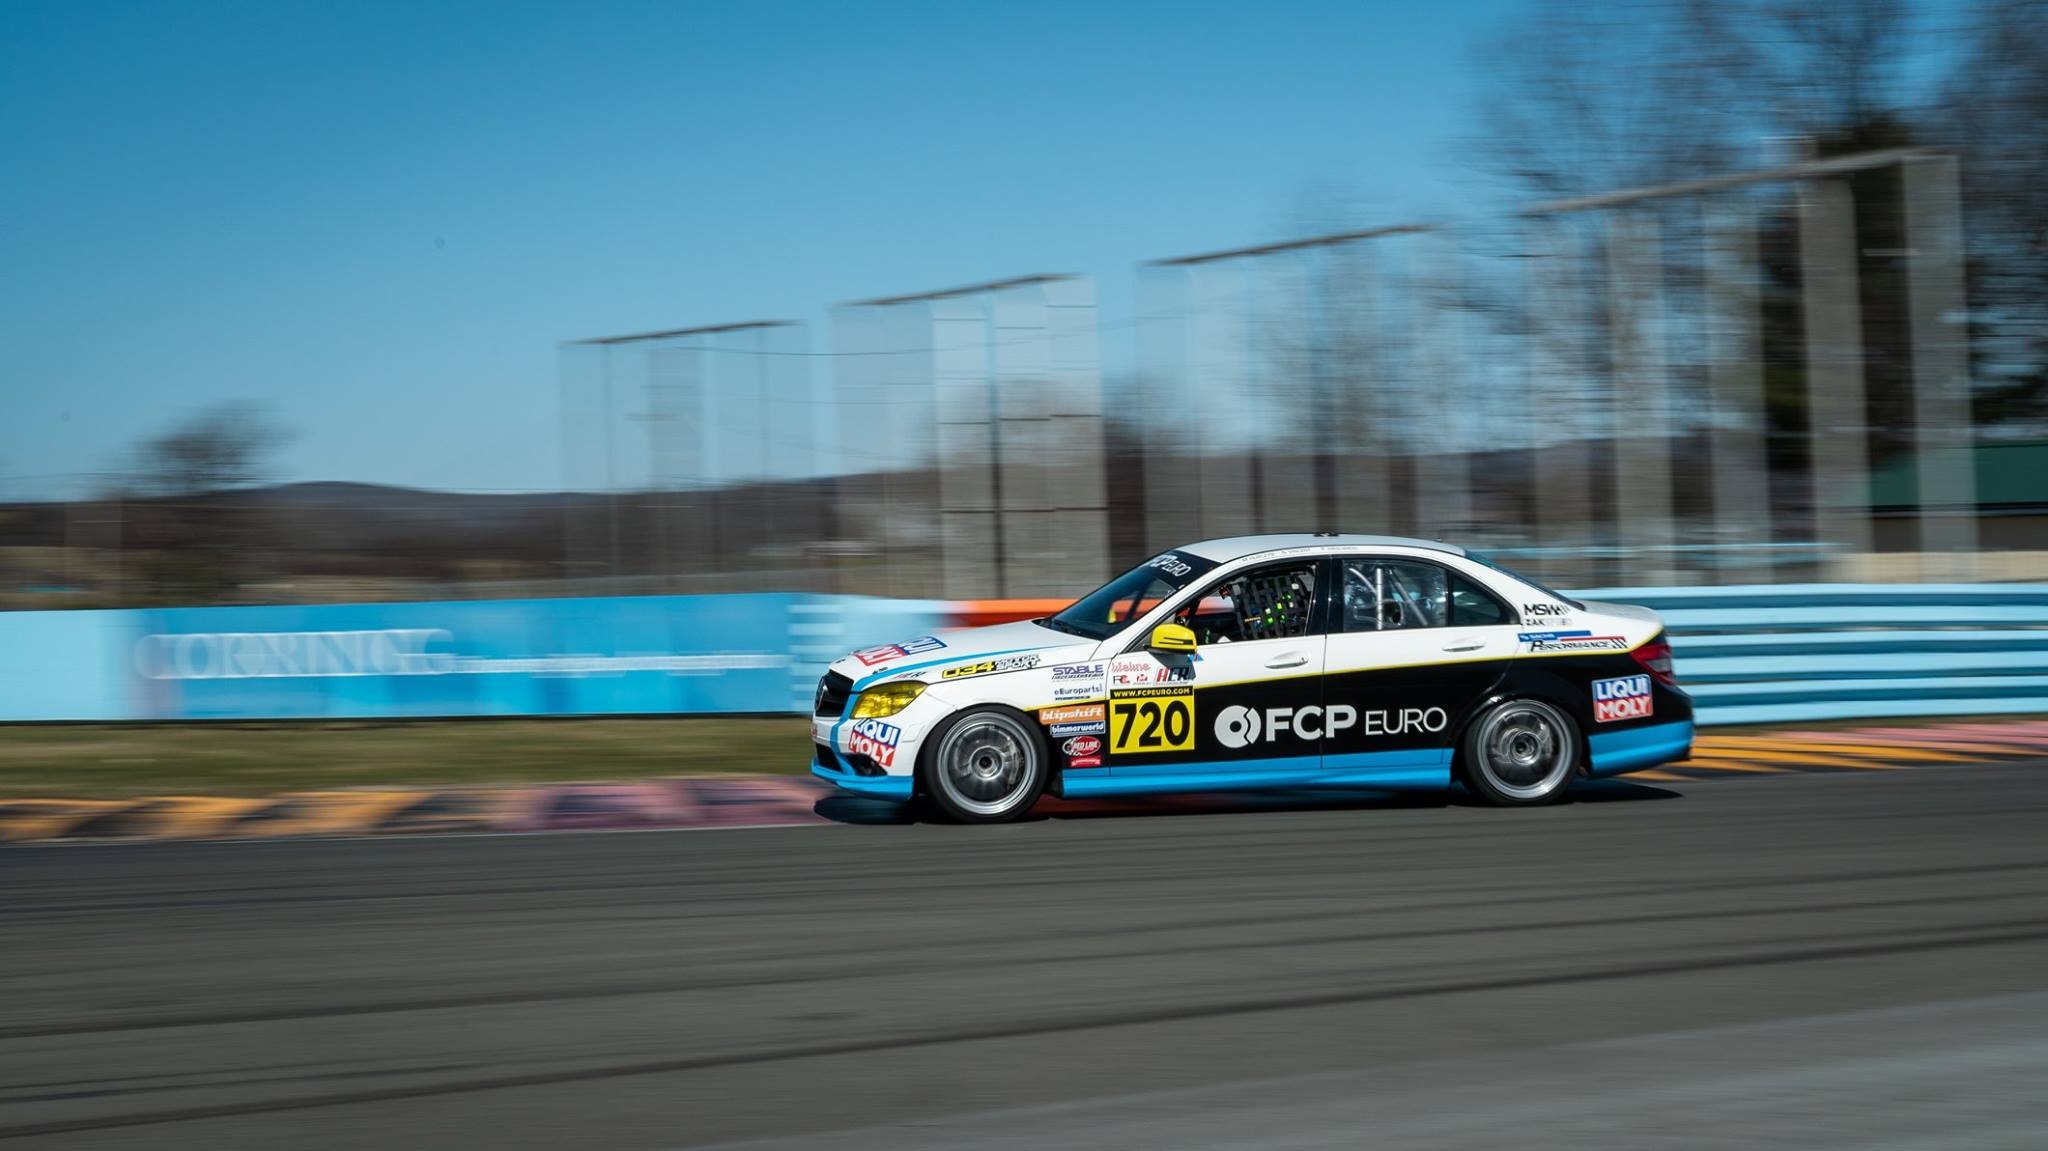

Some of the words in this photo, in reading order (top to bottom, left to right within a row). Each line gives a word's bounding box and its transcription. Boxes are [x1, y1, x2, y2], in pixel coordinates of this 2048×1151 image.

[1053, 665, 1103, 675] STABLE
[1113, 687, 1190, 697] WWW.FCPEURO.COM
[1597, 677, 1648, 700] LIQUI
[1598, 696, 1650, 719] MOLY
[1115, 700, 1190, 749] 720
[1266, 705, 1357, 742] FCP
[1365, 706, 1448, 736] EURO
[850, 732, 895, 764] MOLY
